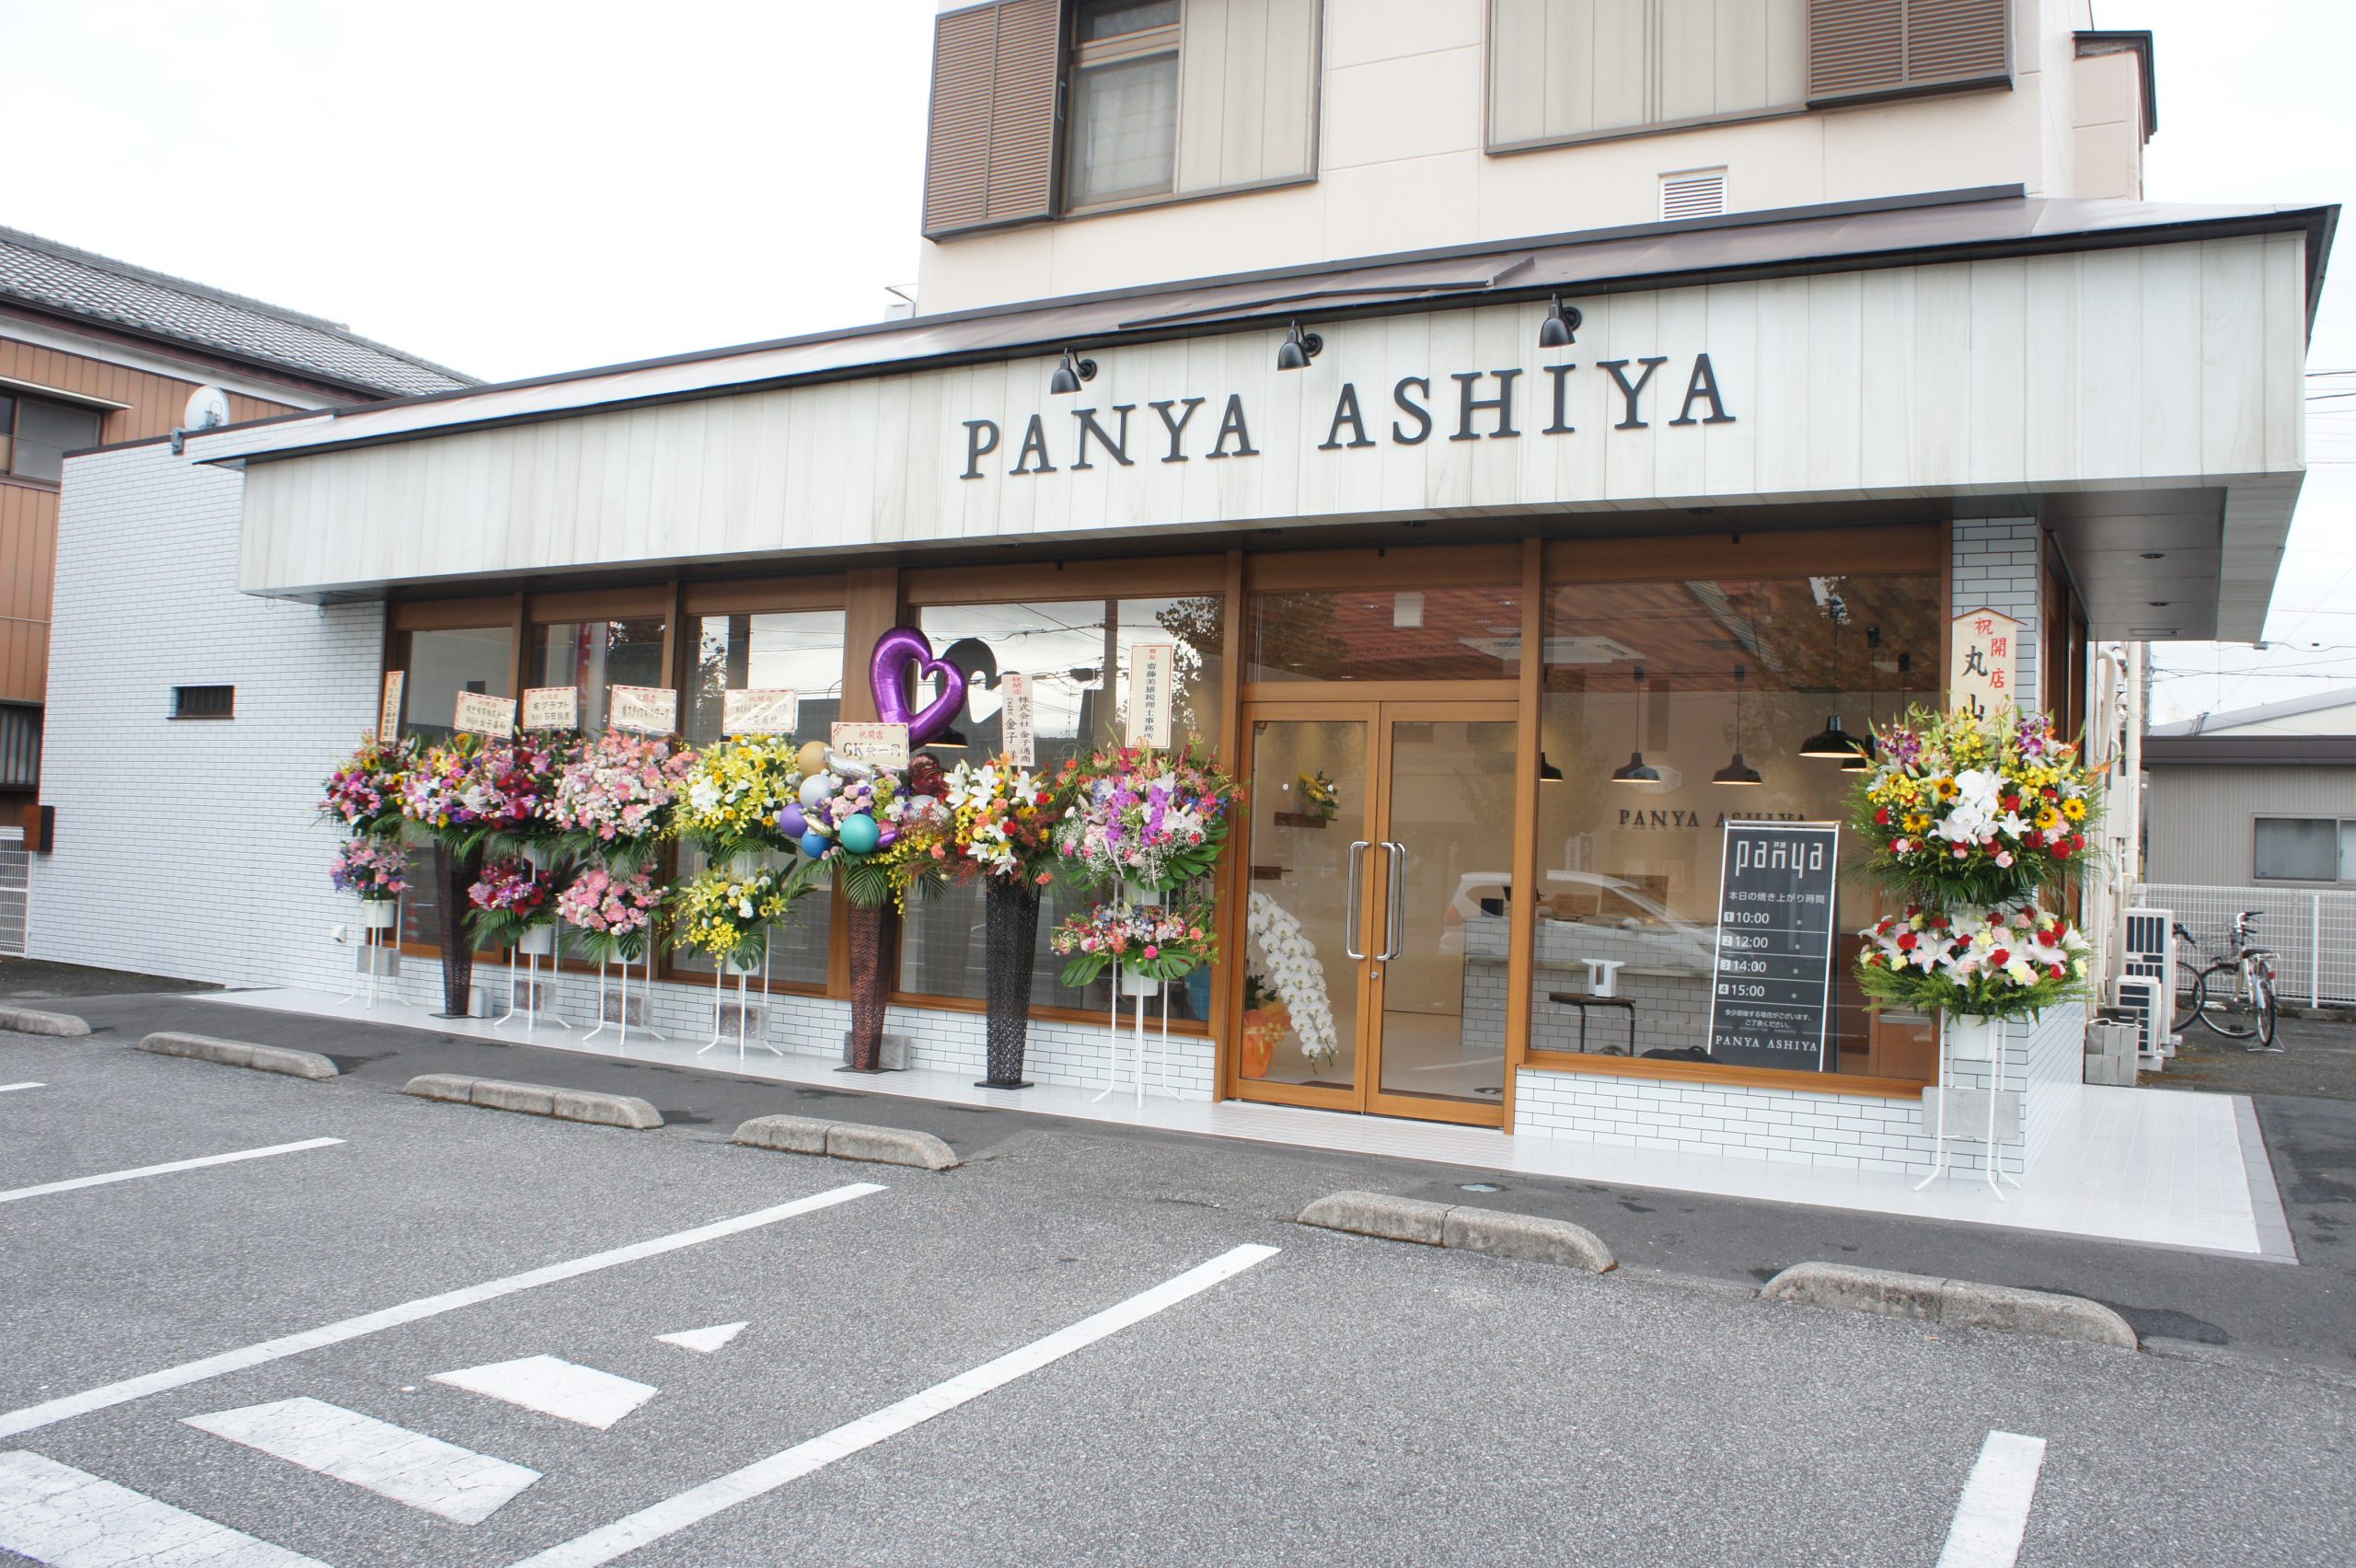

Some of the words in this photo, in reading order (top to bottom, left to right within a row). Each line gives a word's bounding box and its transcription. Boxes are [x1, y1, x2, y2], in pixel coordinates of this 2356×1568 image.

[959, 394, 1259, 479] PANYA
[1318, 353, 1736, 451] ASHIYA
[1975, 617, 1993, 635] 祝
[1989, 637, 2007, 689] 開店
[1618, 810, 1701, 827] PANYA
[1735, 840, 1823, 879] panya
[1728, 891, 1826, 905] 本日の焼き上がり時間
[1736, 913, 1770, 924] 10:00
[1735, 937, 1769, 948] 12:00
[1733, 961, 1767, 972] 14:00
[1731, 985, 1765, 997] 15:00
[1715, 1035, 1760, 1048] PANYA
[1767, 1039, 1819, 1052] ASHIYA
